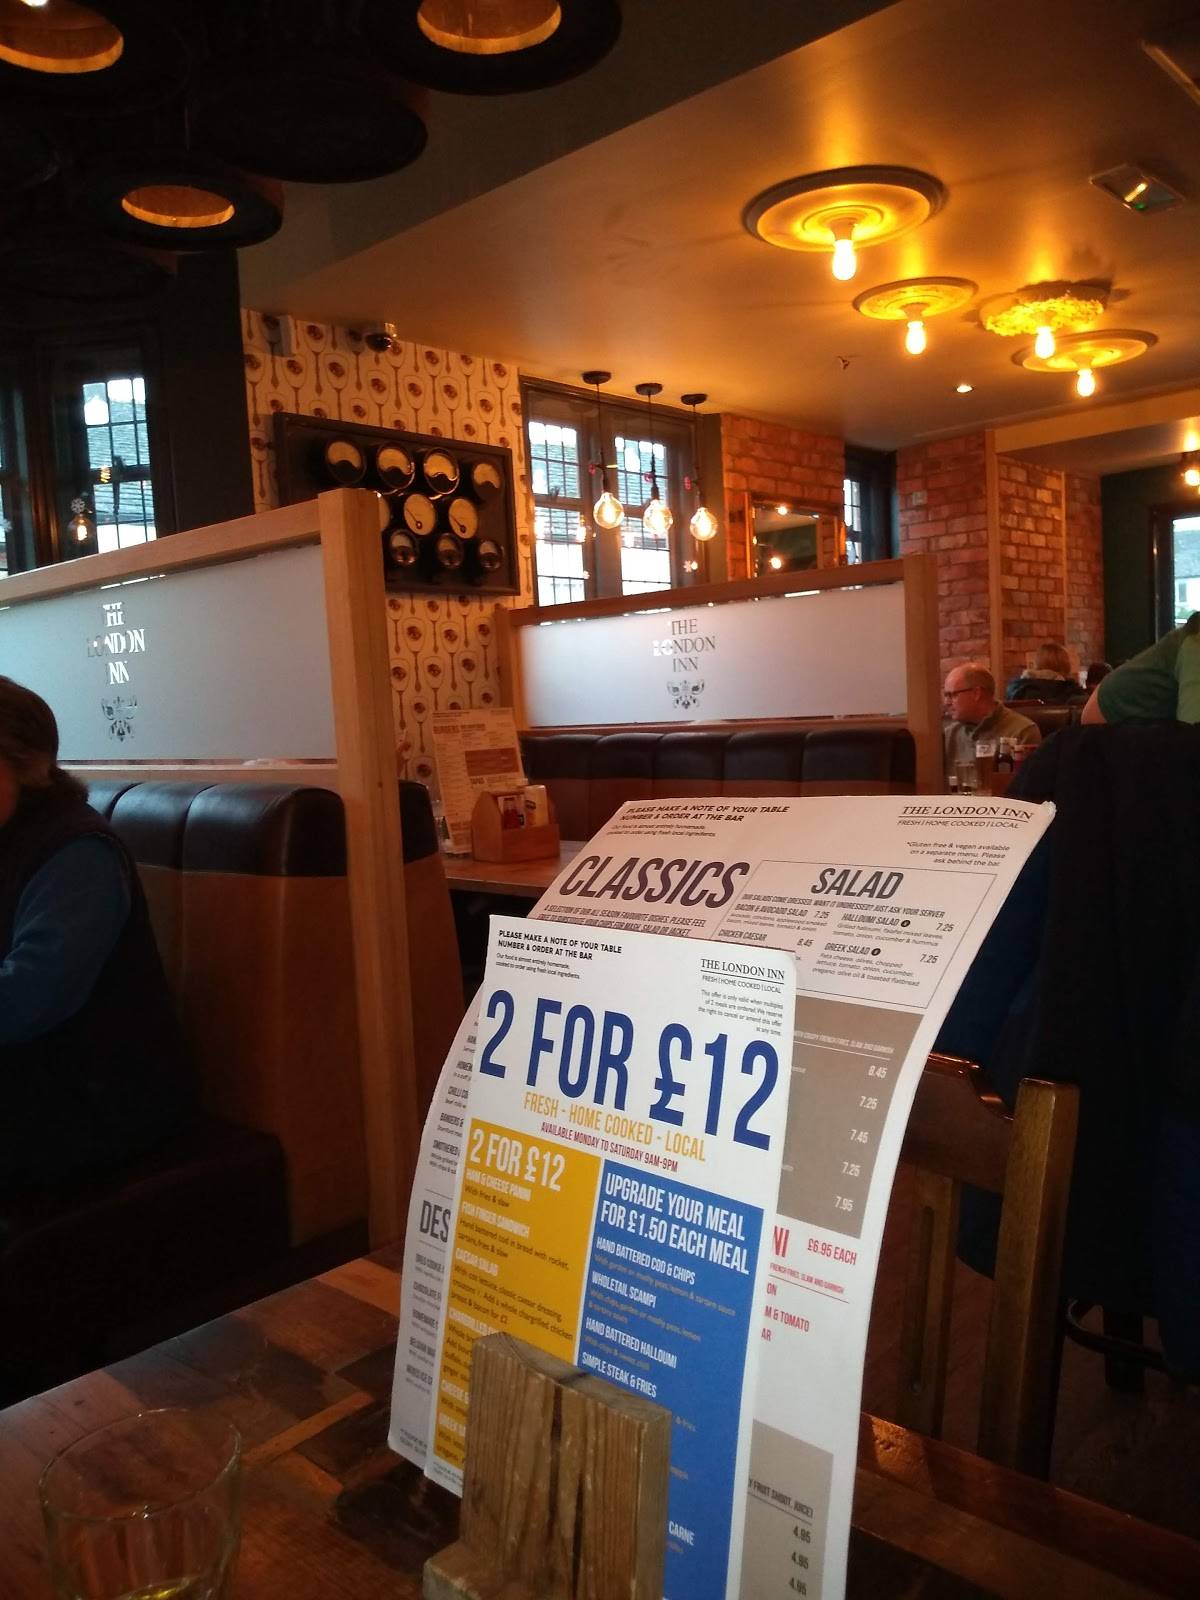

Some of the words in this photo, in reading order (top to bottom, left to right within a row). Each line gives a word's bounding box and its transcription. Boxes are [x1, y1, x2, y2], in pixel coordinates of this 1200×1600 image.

[672, 619, 698, 635] THE
[653, 636, 716, 656] LONDON
[673, 657, 698, 672] INN
[903, 806, 933, 815] THE
[934, 806, 1000, 816] LONDON
[1001, 808, 1033, 819] INN
[990, 821, 1020, 829] LOCAL
[955, 843, 976, 851] vegan
[978, 843, 1010, 851] available
[559, 856, 750, 908] CLASSICS
[811, 867, 904, 899] SALAD
[736, 903, 754, 912] BACON
[760, 905, 788, 915] AVOCADO
[788, 908, 808, 917] SALAD
[815, 910, 831, 919] 7.25
[902, 906, 919, 914] YOUR
[919, 909, 945, 917] SERVER
[669, 916, 692, 925] PLEASE
[692, 919, 707, 927] FEEL
[841, 913, 876, 925] HALLOUMI
[876, 917, 899, 927] SALAD
[936, 923, 955, 932] 7.25
[499, 930, 523, 940] PLEASE
[524, 934, 542, 943] MAKE
[550, 937, 568, 946] NOTE
[569, 939, 579, 947] OF
[580, 941, 599, 950] YOUR
[600, 944, 623, 954] TABLE
[719, 928, 744, 938] CHICKEN
[743, 931, 767, 941] CAESAR
[498, 940, 525, 950] NUMBER
[532, 945, 554, 954] ORDER
[554, 948, 564, 956] AT
[565, 950, 578, 958] THE
[579, 952, 593, 961] BAR
[824, 943, 848, 953] GREEK
[848, 946, 871, 955] SALAD
[920, 954, 939, 964] 7.25
[701, 959, 720, 970] THE
[722, 961, 765, 977] LONDON
[767, 968, 785, 980] INN
[721, 977, 737, 986] HOME
[738, 980, 761, 990] COOKED
[764, 985, 781, 994] LOCAL
[479, 989, 516, 1078] 2
[526, 997, 634, 1112] FOR
[649, 1022, 779, 1151] £12
[859, 1095, 878, 1110] 7.25
[524, 1091, 559, 1119] FRESH
[569, 1104, 603, 1130] HOME
[604, 1114, 654, 1146] COOKED
[664, 1132, 706, 1163] LOCAL
[850, 1129, 868, 1144] 7.45
[541, 1121, 573, 1142] AVAILABLE
[574, 1132, 601, 1150] MONDAY
[601, 1140, 610, 1153] TO
[610, 1142, 644, 1162] SATURDAY
[644, 1152, 679, 1173] 9AM-9PM
[470, 1128, 484, 1164] 2
[486, 1132, 523, 1177] FOR
[524, 1145, 565, 1193] £12
[841, 1161, 861, 1177] 7.25
[605, 1172, 667, 1213] UPGRADE
[667, 1191, 704, 1227] YOUR
[705, 1204, 746, 1242] MEAL
[835, 1195, 854, 1212] 7.95
[419, 1199, 452, 1244] DES
[600, 1199, 627, 1230] FOR
[627, 1209, 668, 1244] £1.50
[668, 1223, 708, 1261] EACH
[709, 1237, 750, 1276] MEAL
[534, 1250, 548, 1261] with
[807, 1238, 833, 1258] £6.95
[833, 1246, 857, 1266] EACH
[596, 1236, 616, 1254] HAND
[615, 1243, 651, 1270] BATTERED
[650, 1256, 667, 1278] COD
[666, 1263, 673, 1277] &
[672, 1266, 696, 1287] CHIPS
[592, 1270, 628, 1297] WHOLETAIL
[629, 1286, 657, 1309] SCAMPI
[773, 1309, 779, 1321] &
[780, 1310, 810, 1333] TOMATO
[586, 1317, 605, 1336] HAND
[604, 1326, 641, 1353] BATTERED
[640, 1341, 678, 1369] HALLOUMI
[760, 1328, 772, 1342] AR
[582, 1352, 606, 1374] SIMPLE
[606, 1363, 630, 1385] STEAK
[629, 1374, 637, 1388] &
[636, 1377, 657, 1399] FRIES
[753, 1481, 771, 1497] FRUIT
[668, 1520, 694, 1547] CARNE
